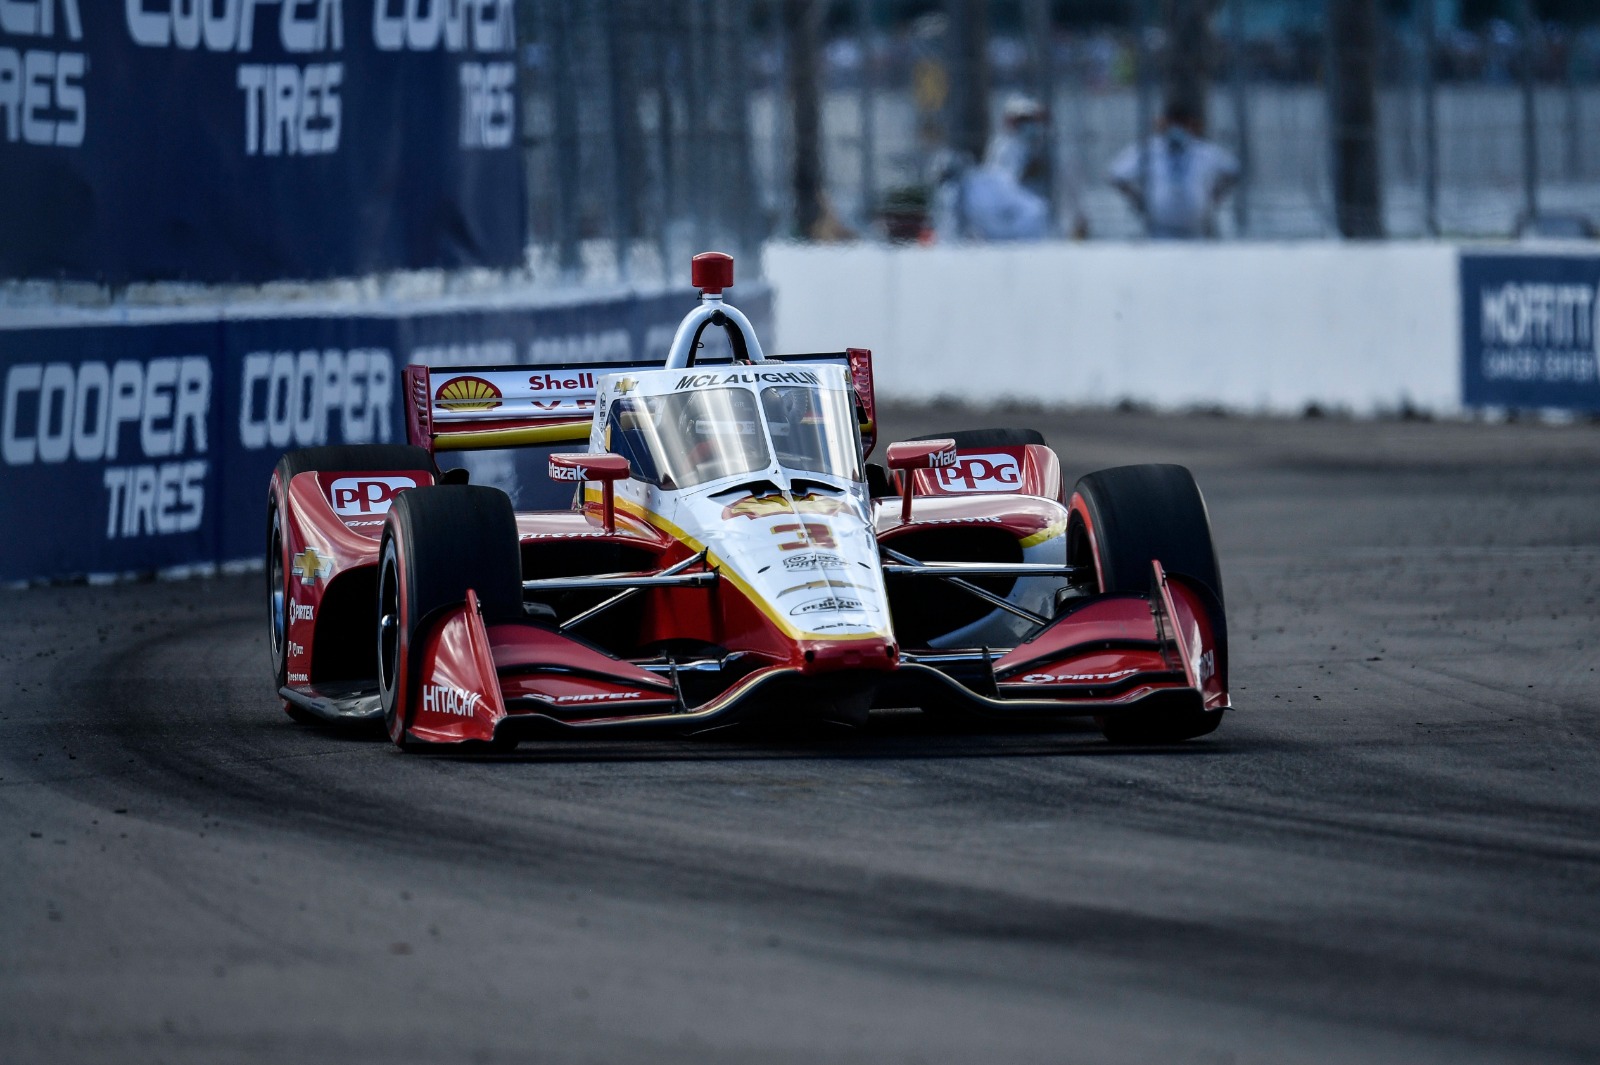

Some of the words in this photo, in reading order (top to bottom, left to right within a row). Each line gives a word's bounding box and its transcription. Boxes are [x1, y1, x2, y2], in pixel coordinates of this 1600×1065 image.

[237, 62, 344, 156] TIRES
[528, 373, 594, 391] Shell
[674, 371, 823, 390] MCLAUGHLIN
[3, 354, 213, 467] COOPER
[239, 348, 396, 450] COOPER
[548, 461, 590, 481] Mazak
[939, 458, 1019, 489] PPG
[103, 459, 210, 540] TIRES
[335, 481, 416, 513] PP
[769, 523, 838, 551] 3
[295, 604, 315, 621] PIRTEK
[1058, 668, 1140, 681] PIRTEK
[423, 684, 482, 718] HITACHI
[557, 691, 641, 703] PIRTEK
